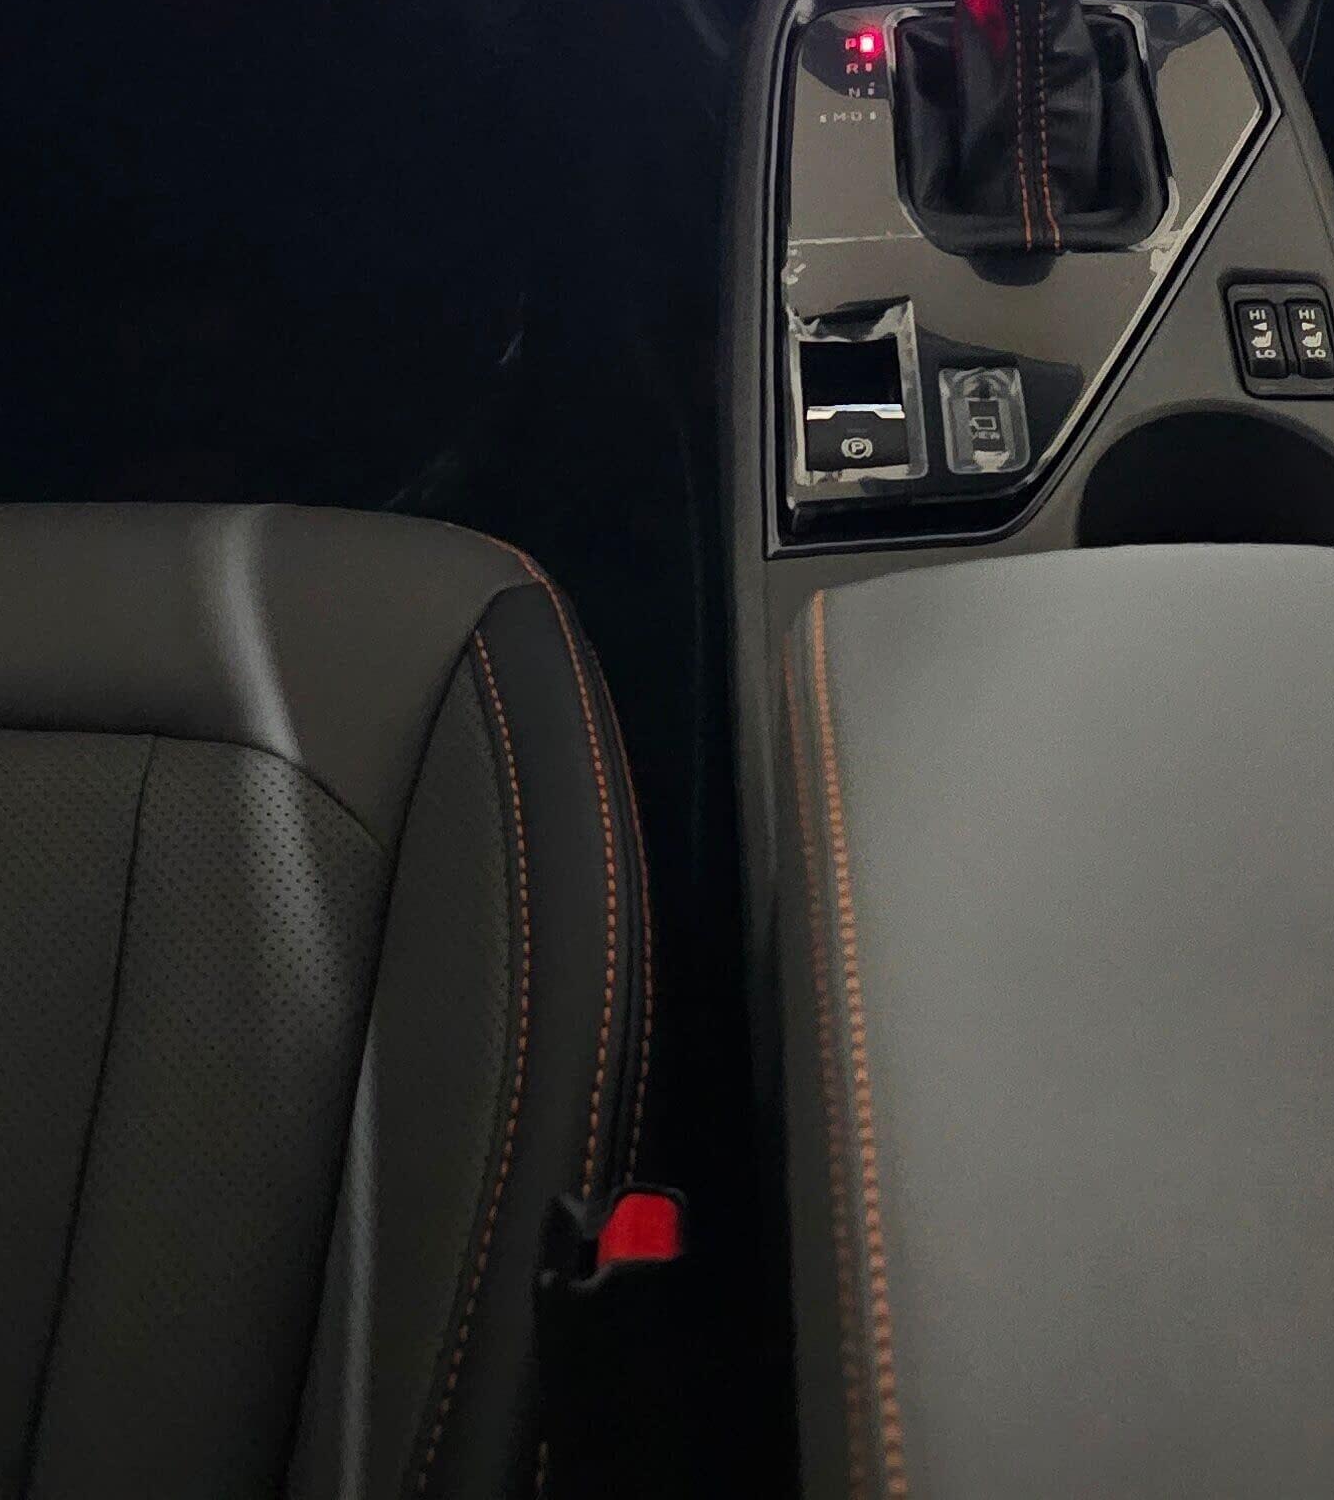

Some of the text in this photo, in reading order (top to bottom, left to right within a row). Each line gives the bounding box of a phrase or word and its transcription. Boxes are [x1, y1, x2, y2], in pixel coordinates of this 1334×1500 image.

[846, 62, 859, 74] R
[849, 87, 860, 98] N
[1249, 309, 1266, 320] HI
[1298, 309, 1316, 320] HI
[1255, 349, 1276, 358] LO
[1307, 348, 1326, 358] LO
